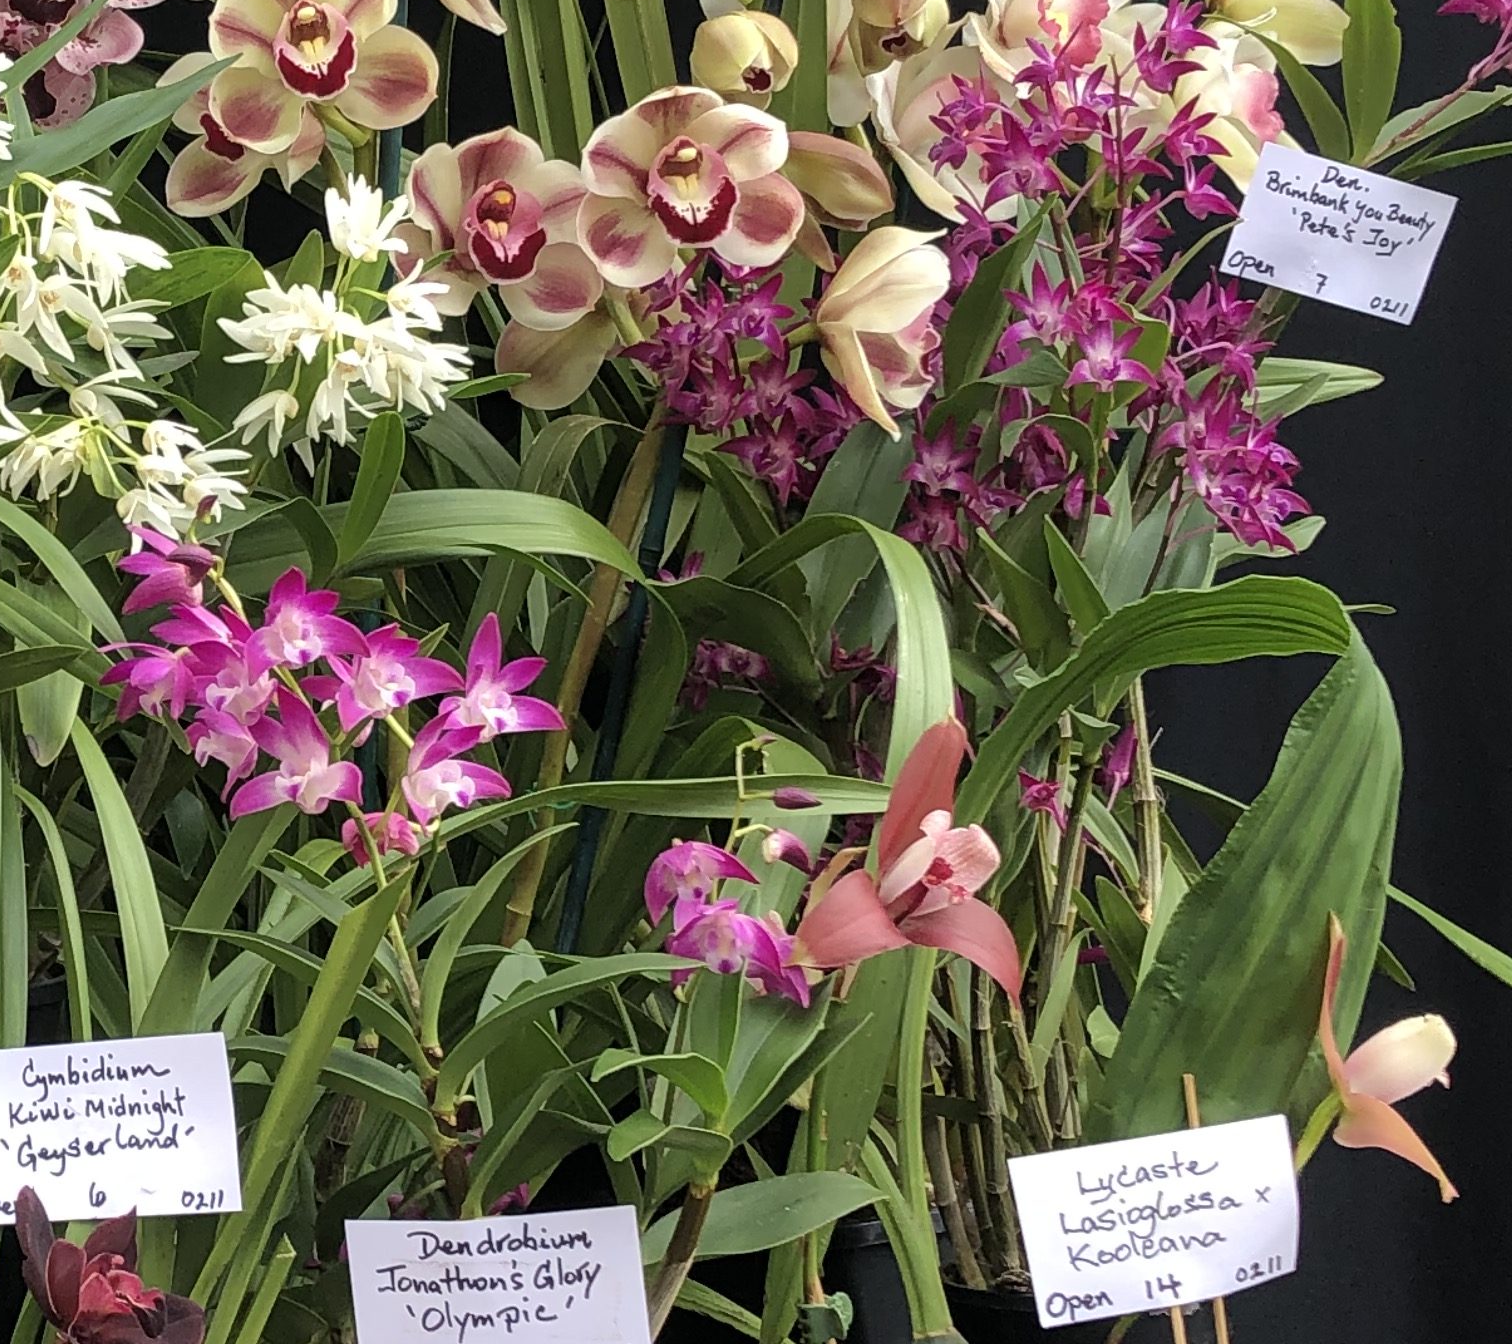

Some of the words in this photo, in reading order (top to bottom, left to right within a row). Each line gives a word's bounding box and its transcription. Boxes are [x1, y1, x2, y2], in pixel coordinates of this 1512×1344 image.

[1321, 166, 1370, 192] Den.
[1265, 170, 1349, 214] Brimbank
[1386, 204, 1436, 242] Beauty
[1227, 251, 1275, 278] Open
[1316, 273, 1328, 294] 7
[1370, 296, 1409, 317] 0211
[22, 1054, 171, 1102] Cymbidium
[85, 1086, 186, 1135] Midnight
[89, 1181, 106, 1207] 6
[181, 1190, 224, 1210] 0211
[1077, 1151, 1219, 1205] Lycaste
[1059, 1190, 1243, 1241] Lasioglossa
[406, 1223, 592, 1260] Dendrobium
[1066, 1230, 1227, 1272] Kooleana
[533, 1257, 601, 1299] Glory
[1046, 1291, 1113, 1321] Open
[1144, 1274, 1182, 1300] 14
[1235, 1255, 1282, 1282] 0211
